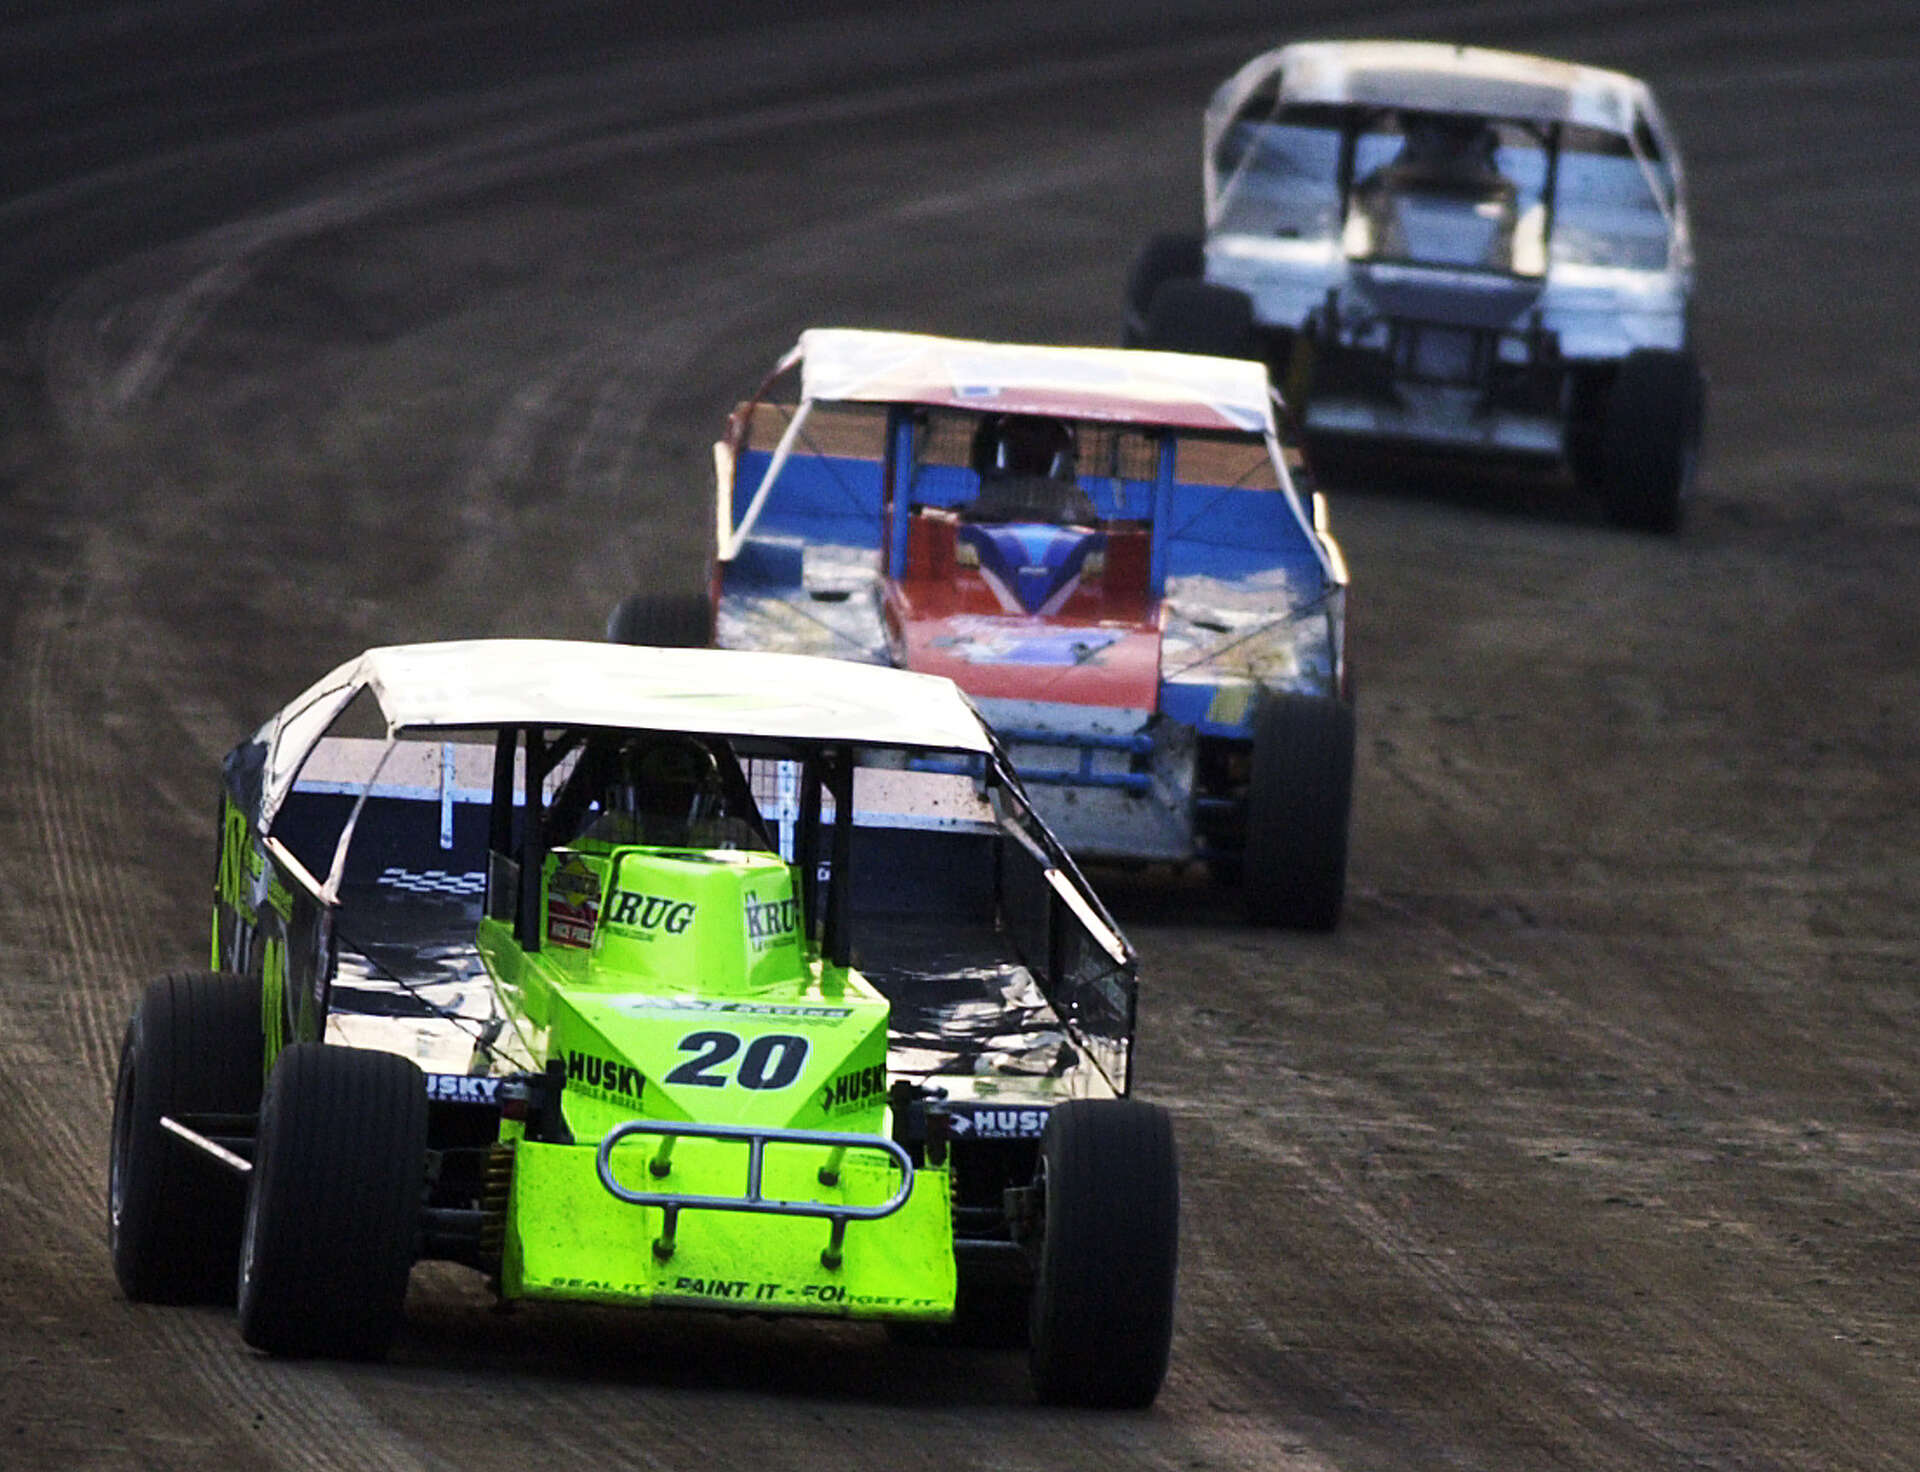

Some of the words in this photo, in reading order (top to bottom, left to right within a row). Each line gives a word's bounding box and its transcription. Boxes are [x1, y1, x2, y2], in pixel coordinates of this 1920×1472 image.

[569, 1050, 647, 1099] HUSKY
[664, 1030, 811, 1092] 20
[676, 1277, 750, 1299] PAINT
[756, 1283, 782, 1300] IT
